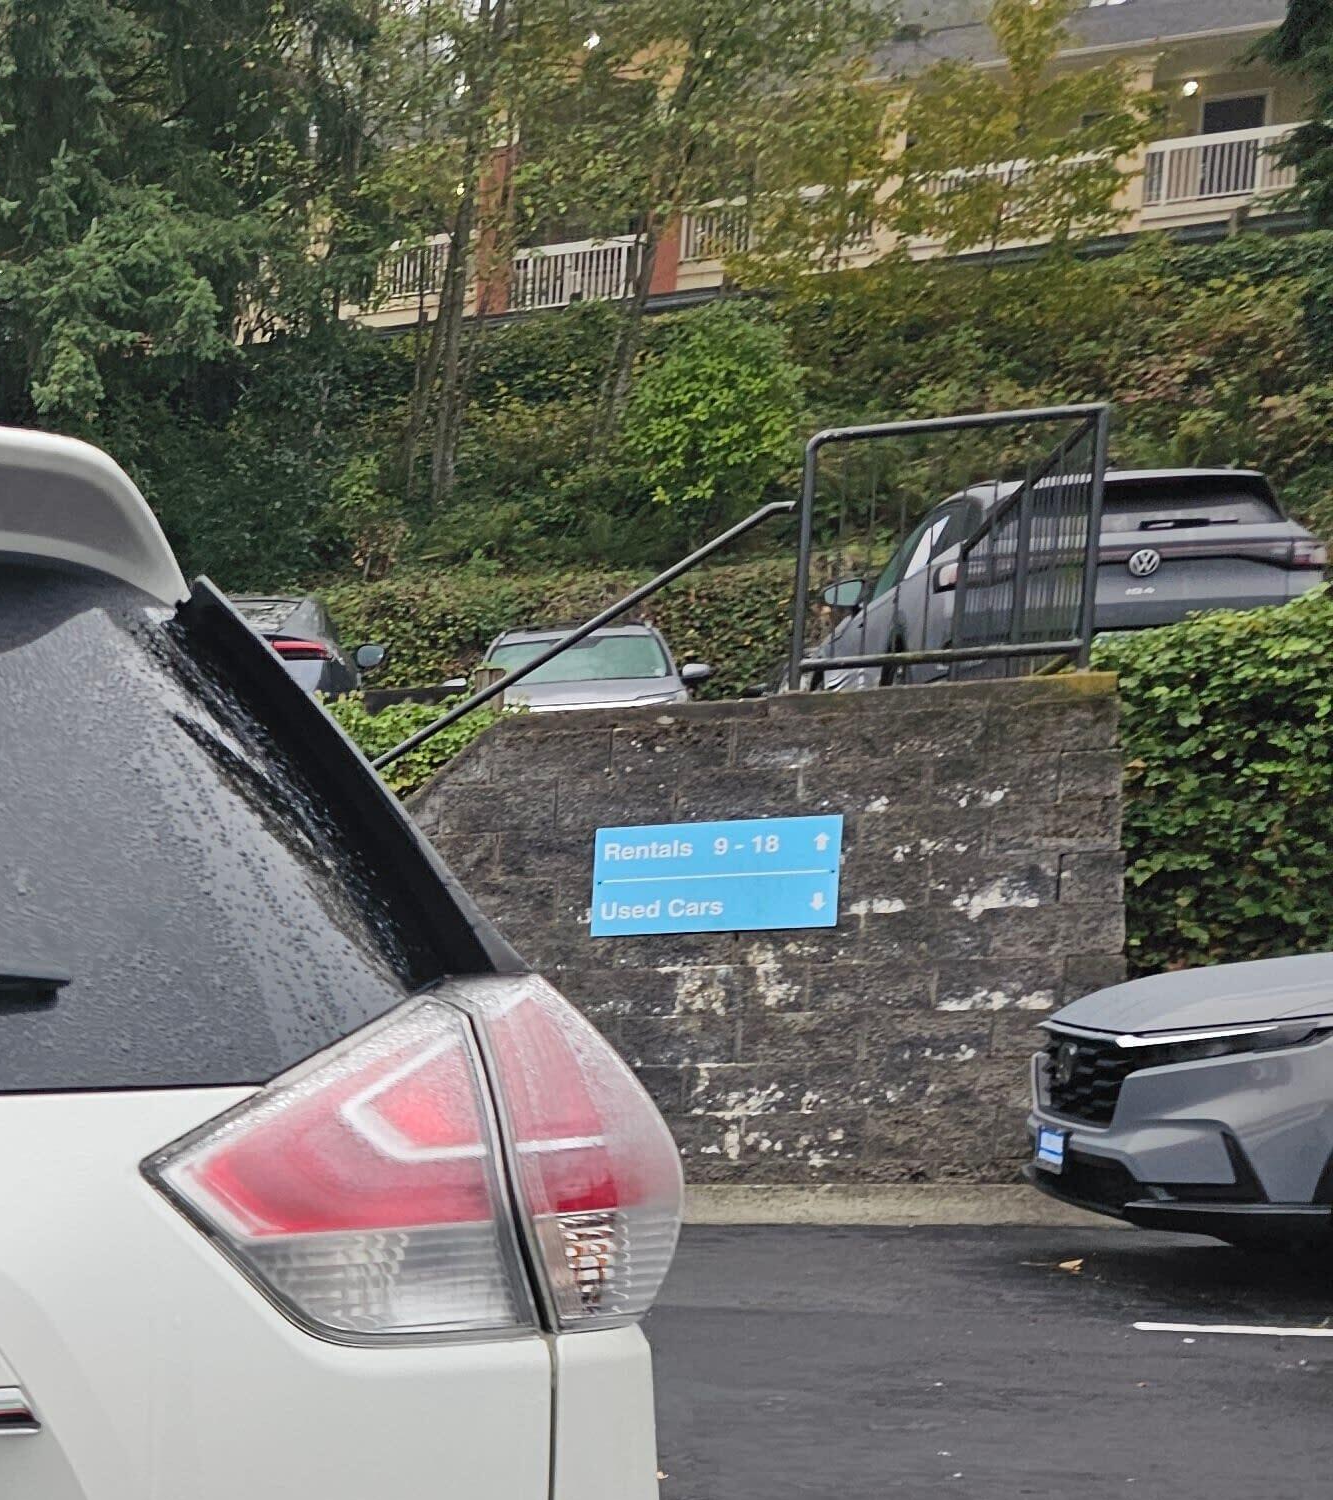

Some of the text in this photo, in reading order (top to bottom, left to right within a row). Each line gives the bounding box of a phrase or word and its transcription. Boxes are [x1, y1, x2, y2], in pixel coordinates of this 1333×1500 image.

[603, 839, 694, 861] Rentals
[713, 836, 729, 855] 9
[751, 834, 779, 854] 18
[600, 898, 724, 920] Used Cars
